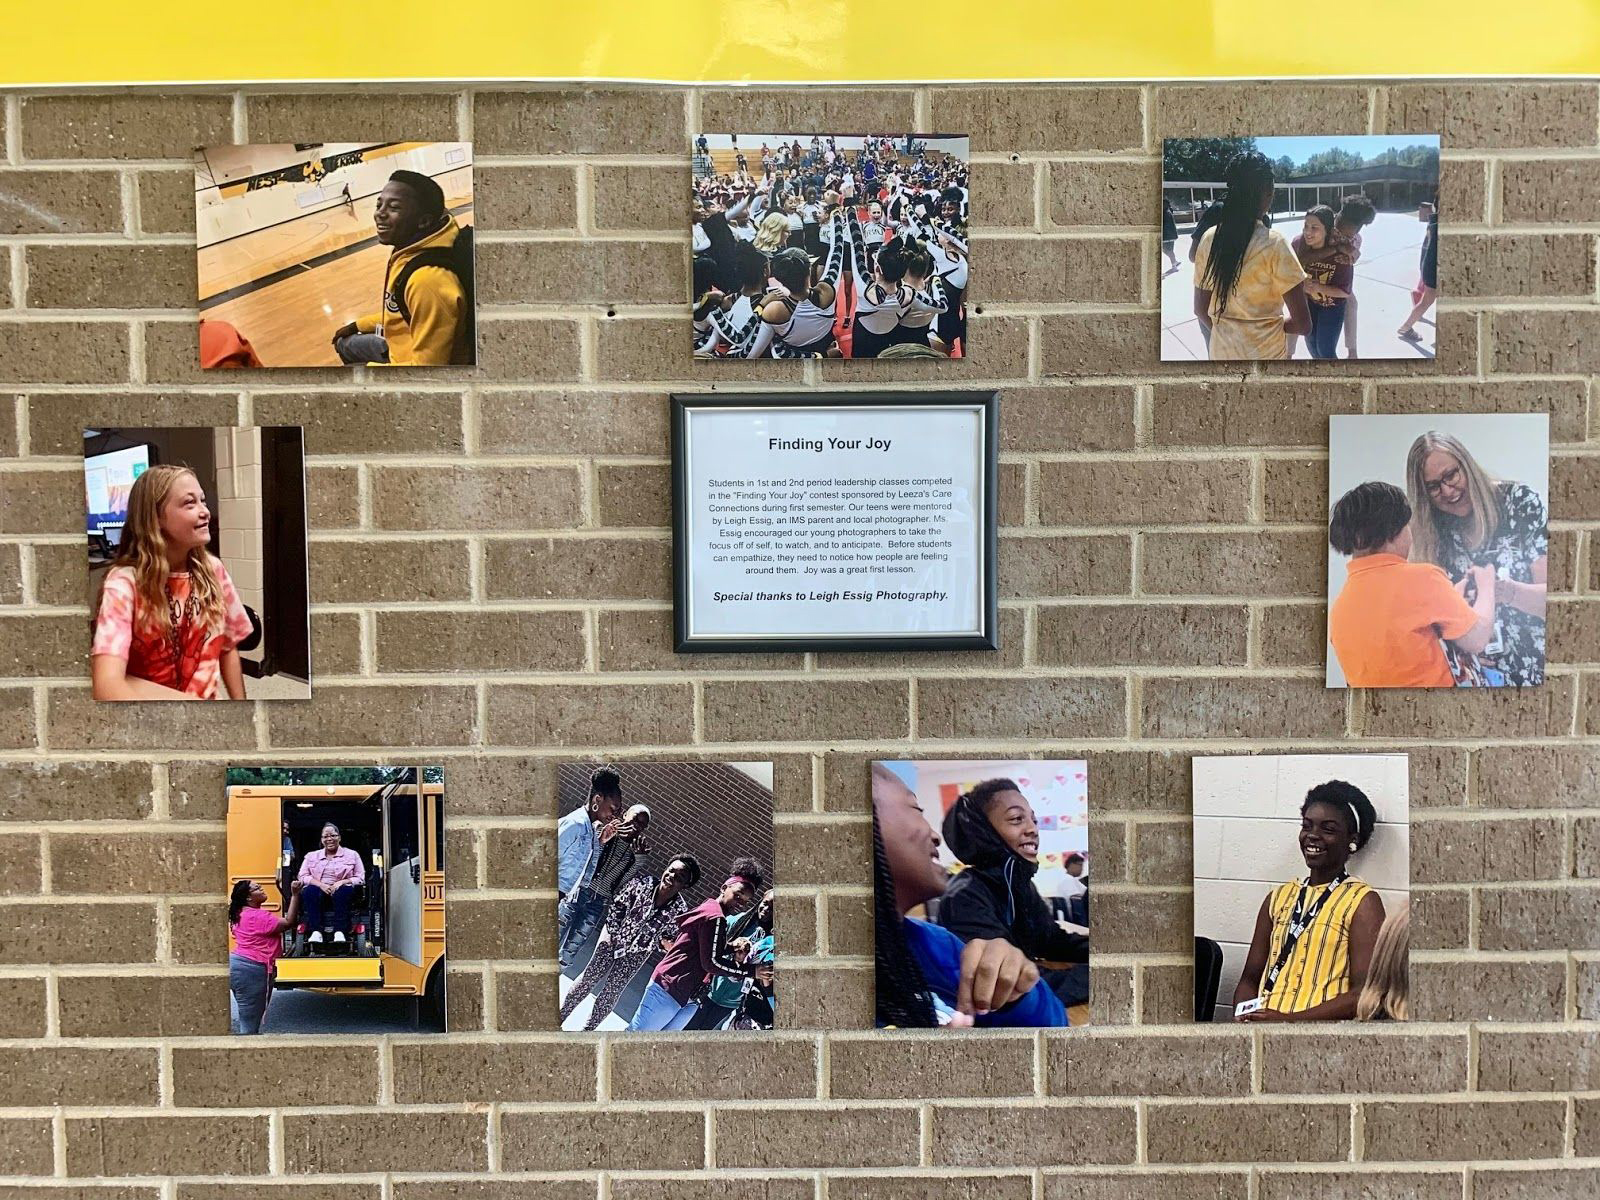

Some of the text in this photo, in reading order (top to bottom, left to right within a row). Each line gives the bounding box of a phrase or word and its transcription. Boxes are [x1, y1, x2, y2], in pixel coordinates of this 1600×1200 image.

[769, 437, 891, 452] Finding Your Joy
[806, 478, 832, 488] period
[834, 478, 877, 488] leadership
[912, 478, 952, 487] competed
[733, 491, 766, 501] "Finding
[790, 491, 807, 501] Joy"
[841, 490, 884, 500] sponsored
[886, 490, 896, 500] by
[762, 504, 788, 513] during
[712, 516, 722, 526] by
[724, 516, 747, 526] Leigh
[749, 516, 774, 526] Essig,
[808, 516, 834, 525] parent
[874, 515, 930, 525] photographer.
[720, 529, 742, 539] Essig
[744, 529, 792, 538] encouraged
[837, 528, 896, 538] photographers
[756, 541, 772, 550] self,
[785, 541, 811, 550] watch,
[842, 540, 882, 550] anticipate.
[730, 554, 775, 563] empathize,
[777, 553, 795, 563] they
[876, 552, 903, 562] people
[921, 552, 948, 562] feeling
[804, 566, 818, 575] Joy
[846, 565, 867, 575] great
[714, 590, 948, 603] Special thanks to Leigh Essig Photography.
